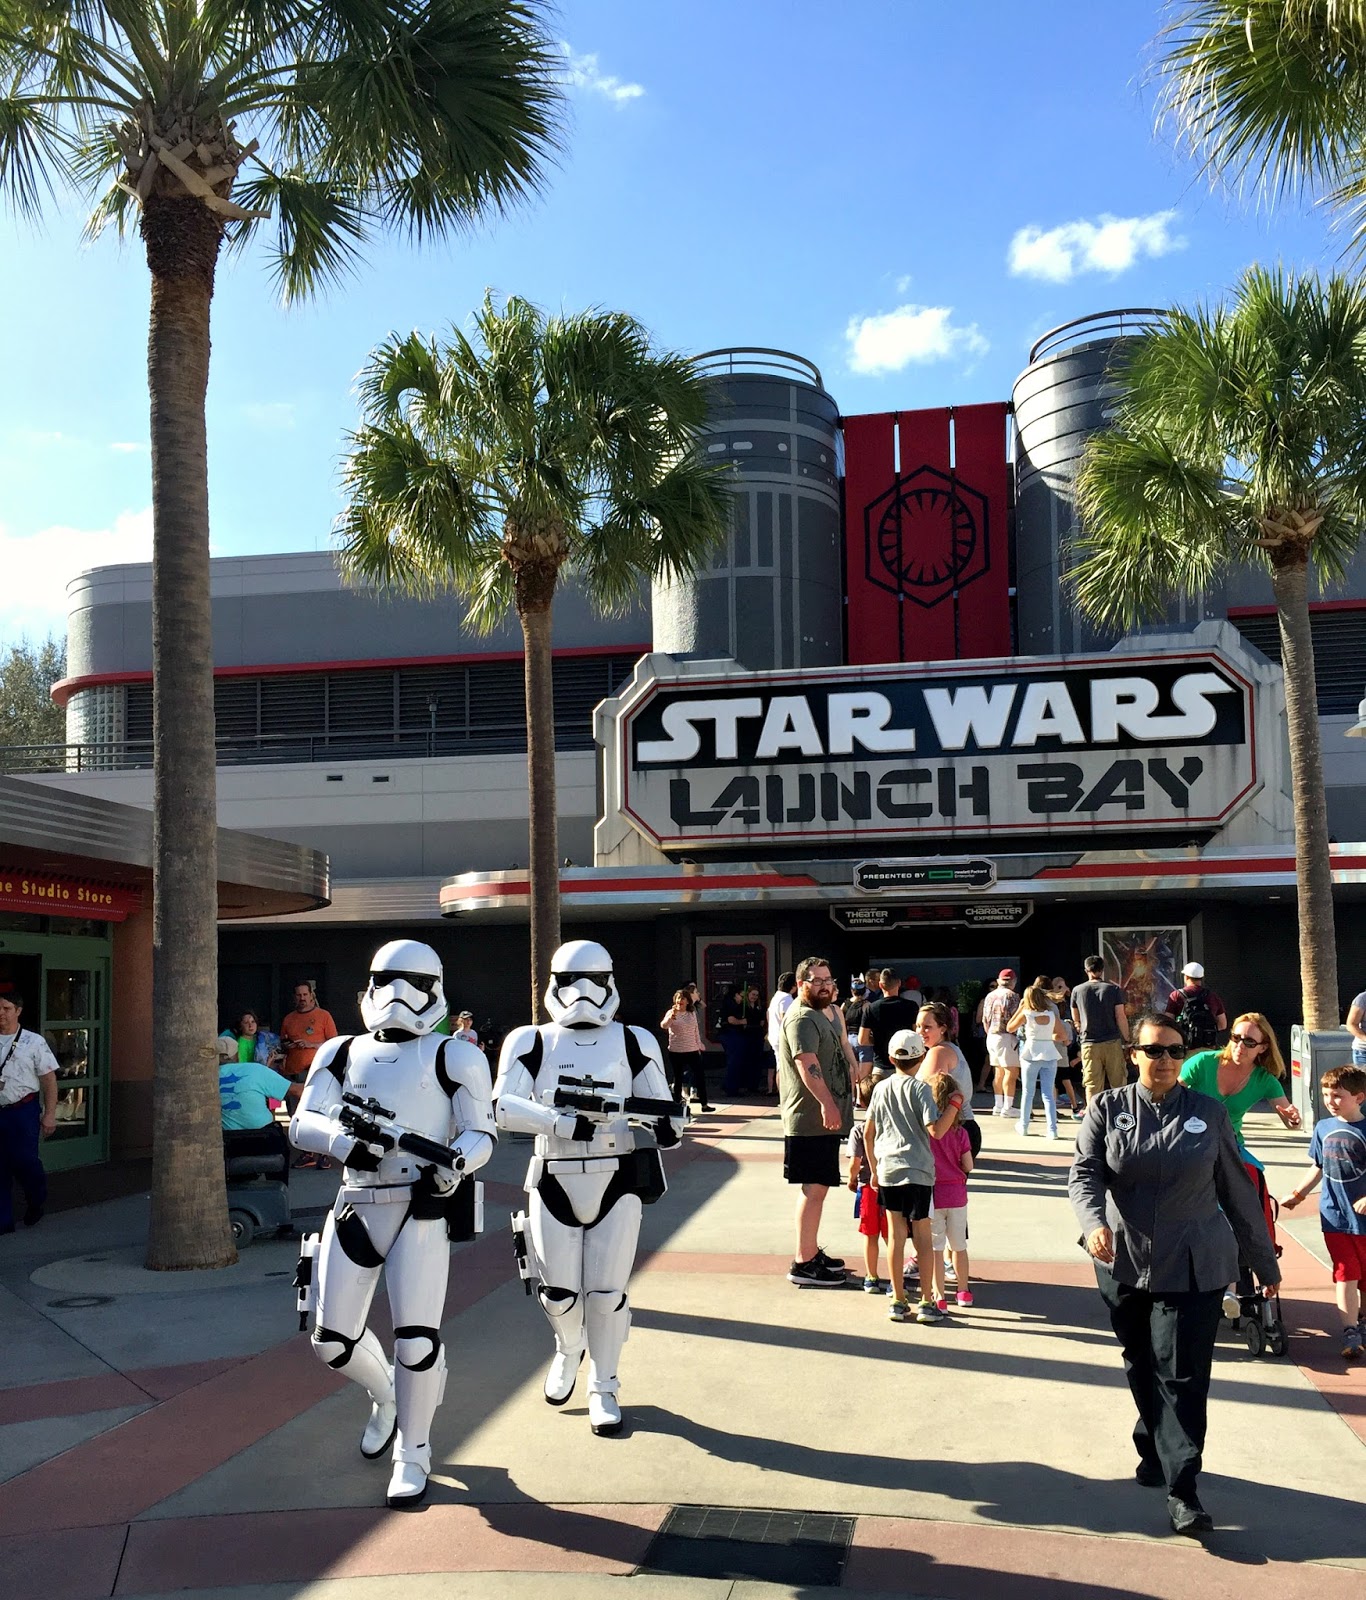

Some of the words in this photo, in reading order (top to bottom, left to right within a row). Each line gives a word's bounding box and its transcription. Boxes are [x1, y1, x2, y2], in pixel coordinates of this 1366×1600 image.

[638, 691, 916, 762] STAR
[923, 672, 1237, 752] WARS
[670, 766, 990, 826] LAUNCH
[1017, 756, 1203, 813] BAY
[21, 880, 70, 899] Studio
[78, 887, 112, 904] Store
[845, 910, 888, 918] THEATER
[965, 907, 1022, 916] CHARACTER
